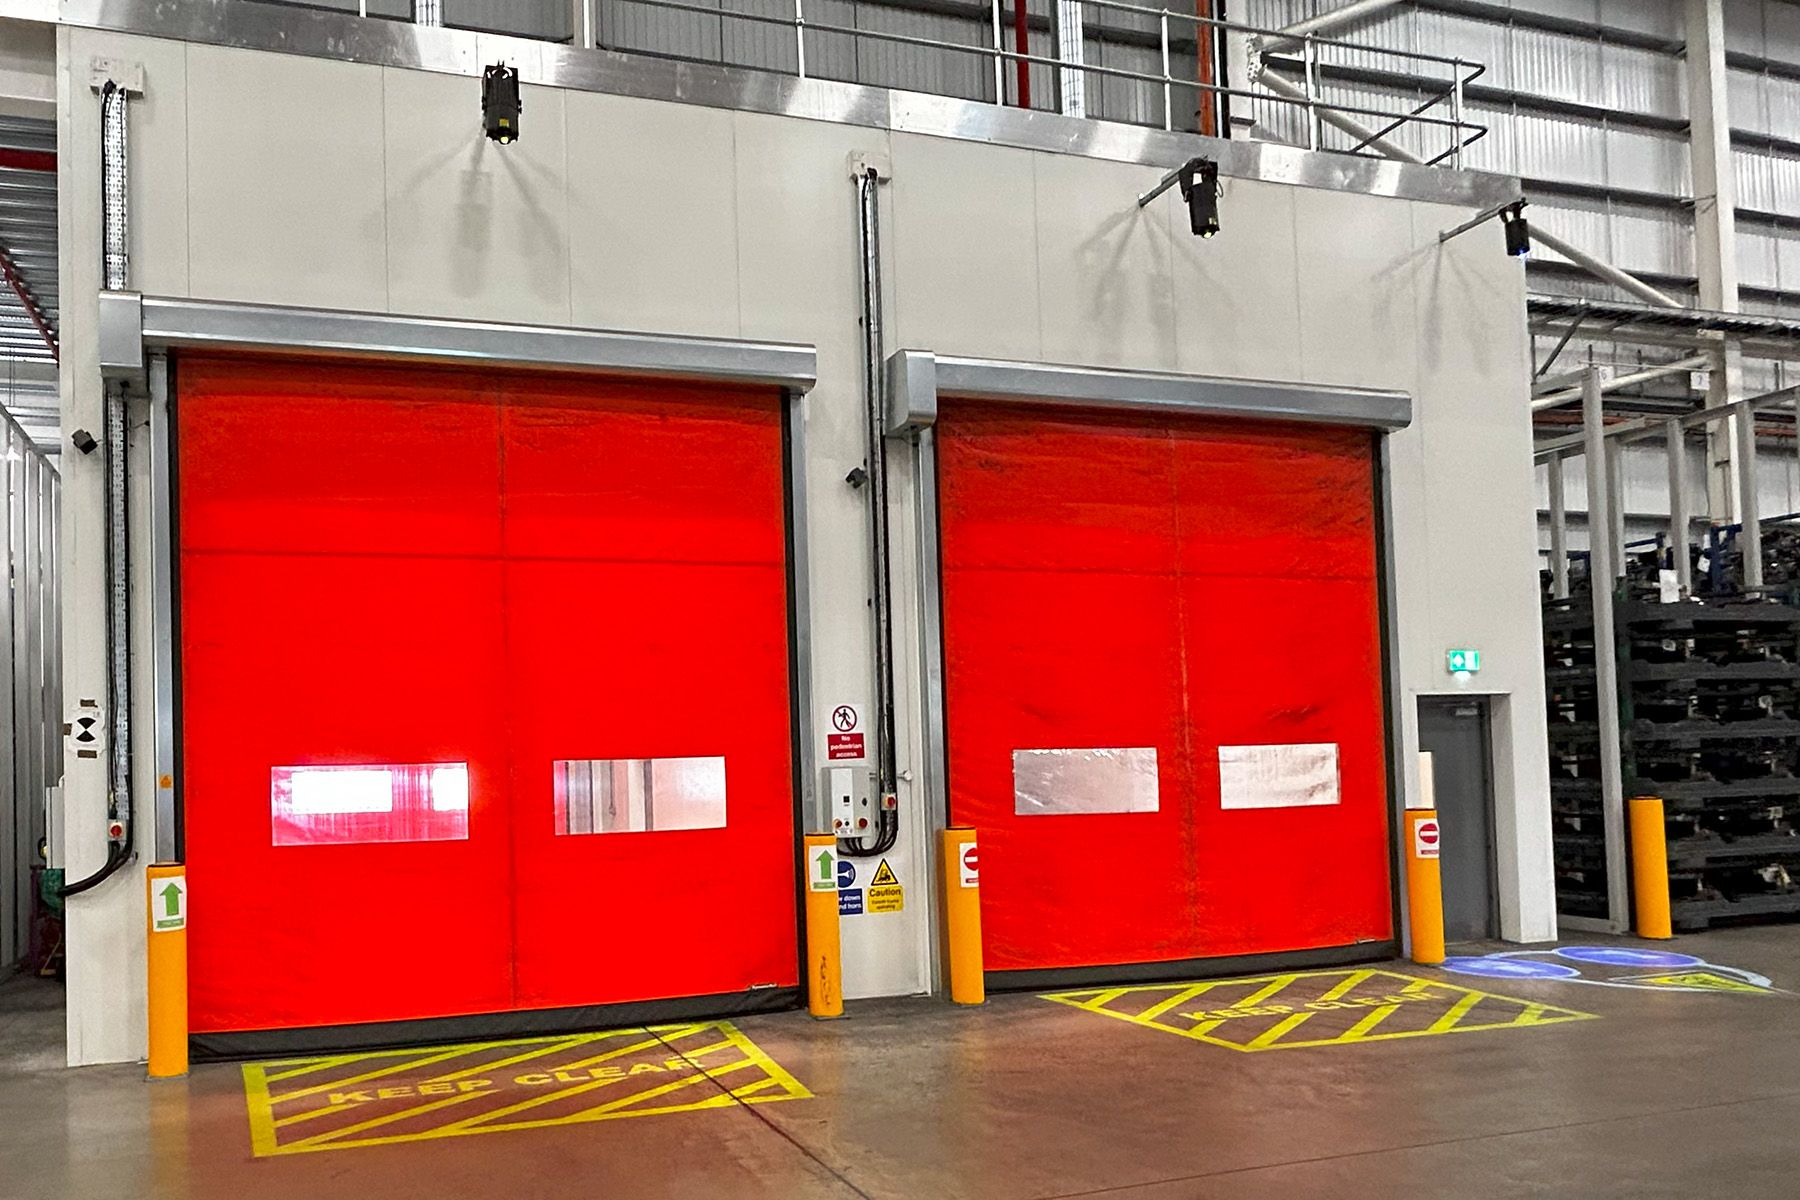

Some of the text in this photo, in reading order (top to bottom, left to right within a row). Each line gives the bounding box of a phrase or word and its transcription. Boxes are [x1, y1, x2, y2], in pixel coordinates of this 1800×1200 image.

[869, 888, 901, 897] Caution
[1178, 992, 1442, 1020] KEEP CLEAR
[328, 1055, 706, 1107] KEEP CLEAR
